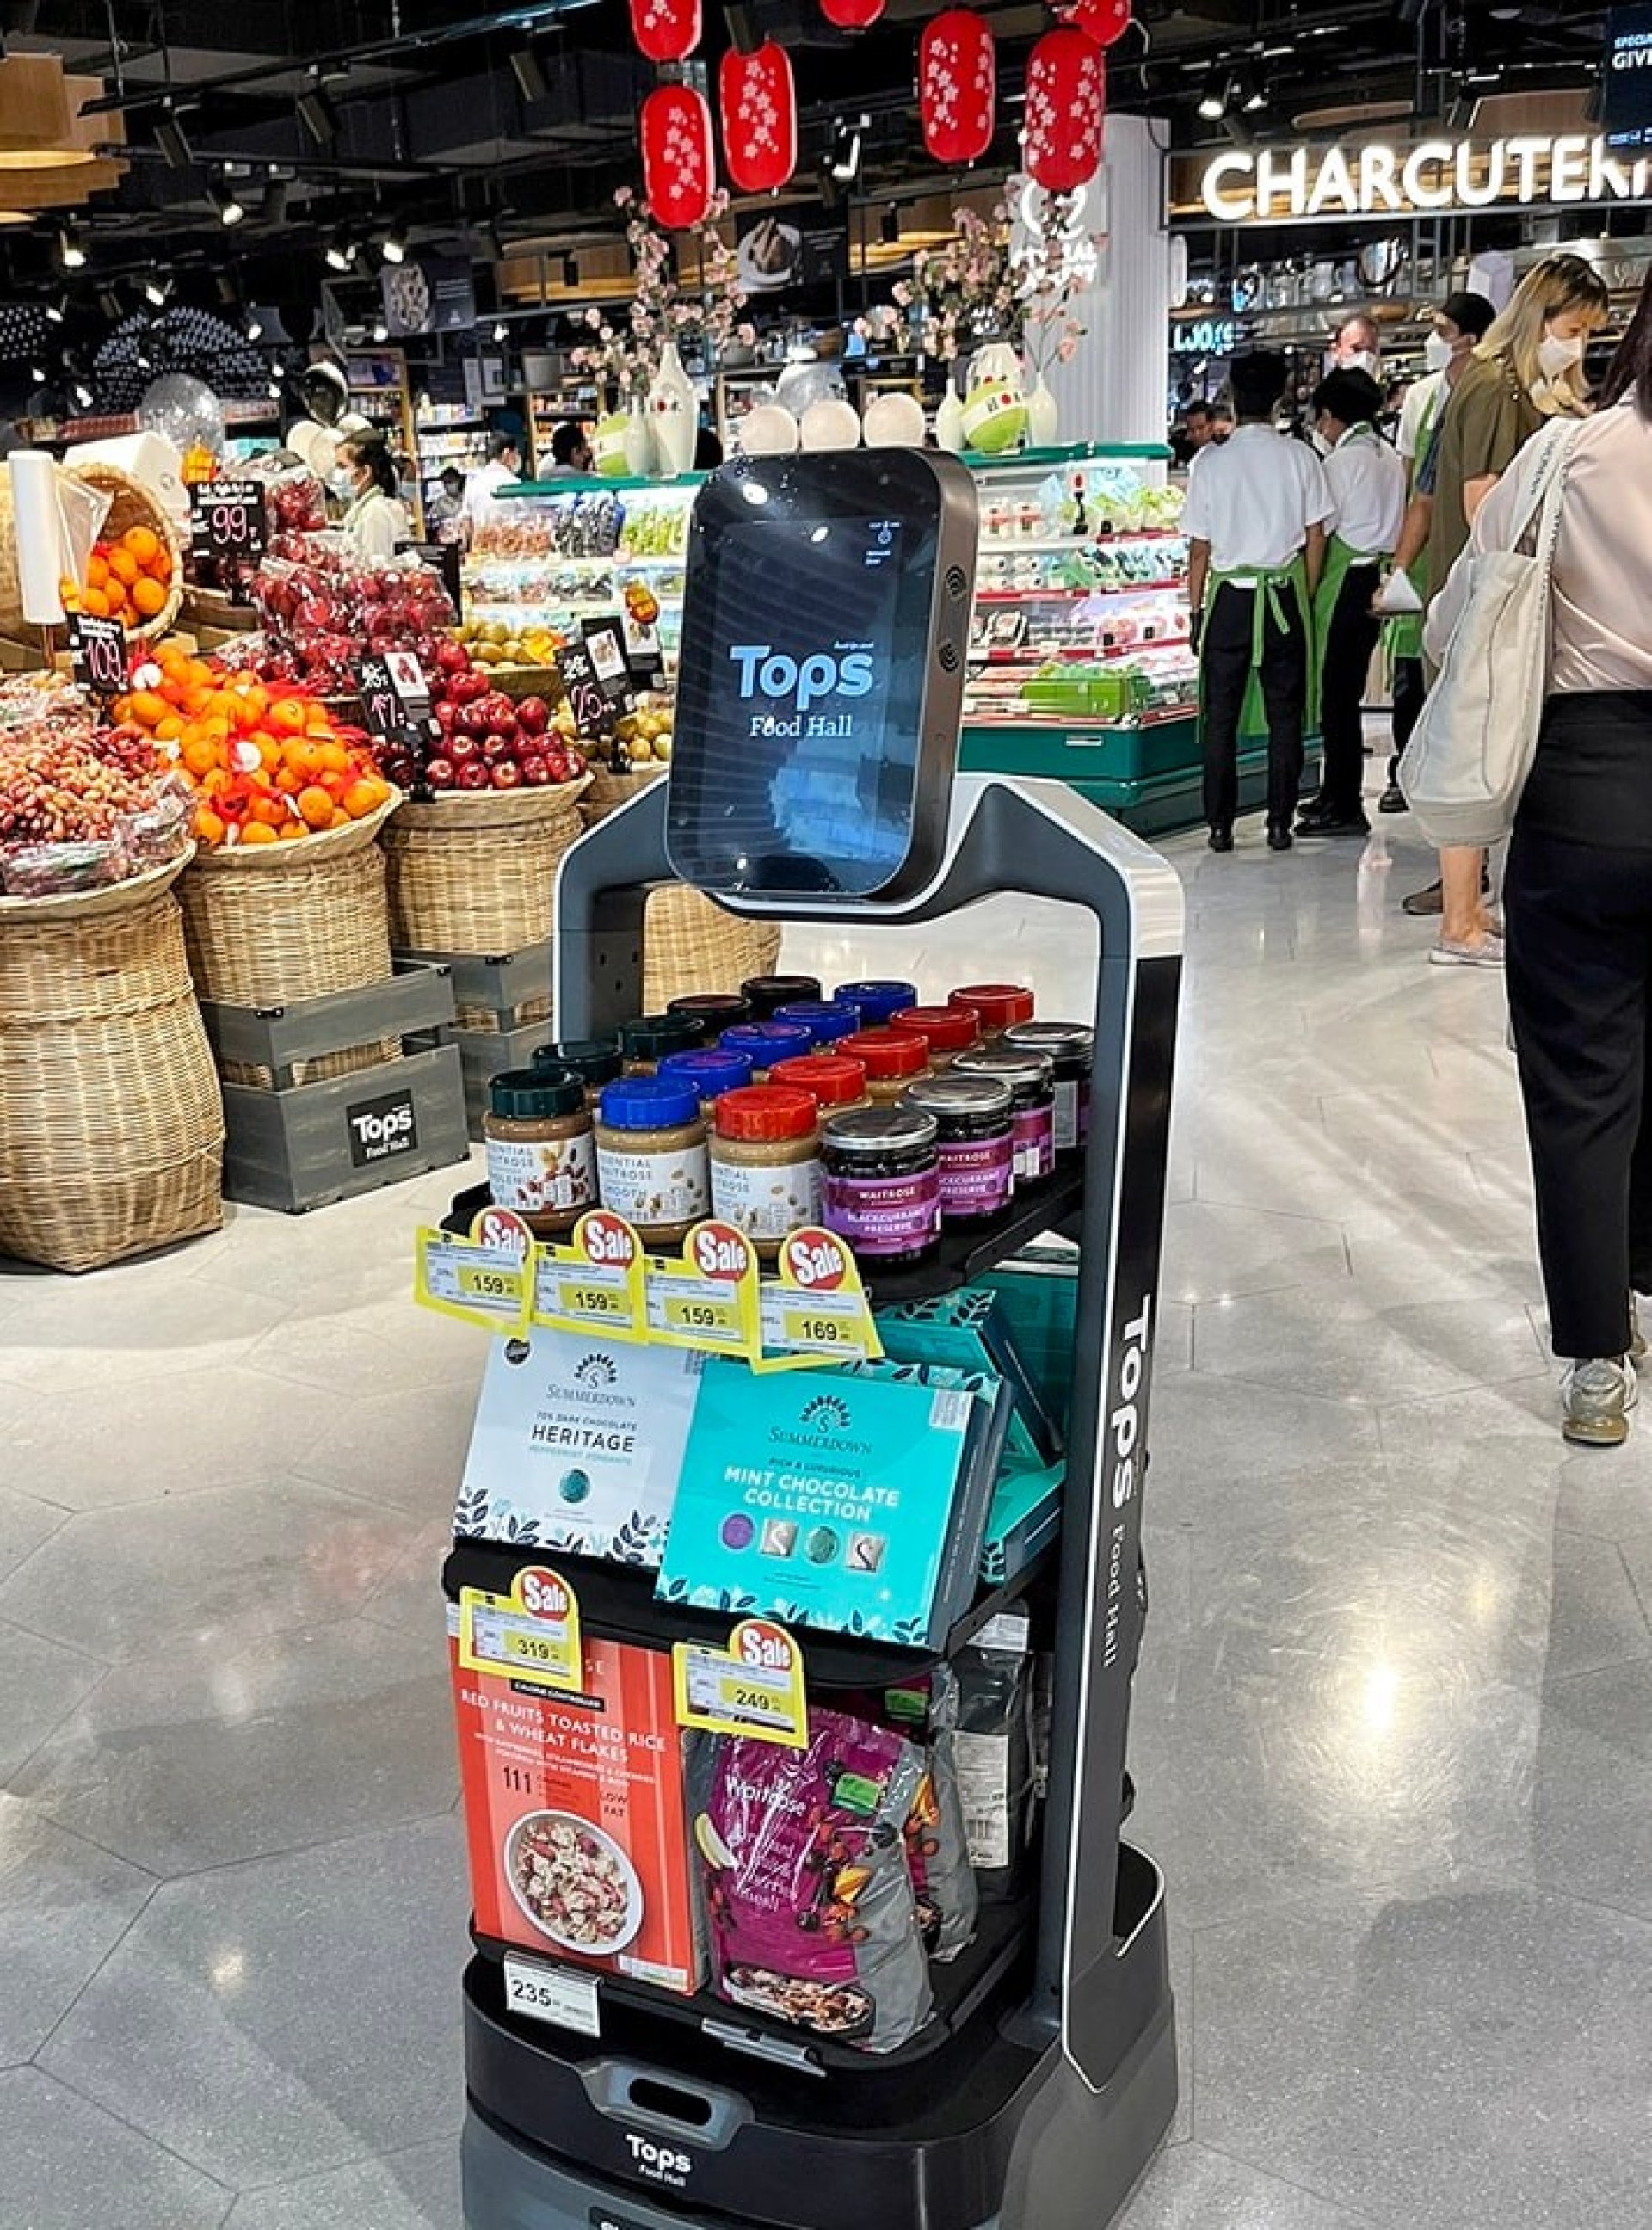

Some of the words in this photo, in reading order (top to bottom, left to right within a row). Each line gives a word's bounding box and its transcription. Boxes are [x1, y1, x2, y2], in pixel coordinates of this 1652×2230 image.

[729, 645, 874, 712] Tops
[749, 715, 801, 738] Food
[805, 715, 854, 738] Hall
[351, 1110, 412, 1143] Tops
[585, 1218, 633, 1260] Sale
[696, 1230, 747, 1272] Sale
[789, 1240, 843, 1284] Sale
[472, 1273, 503, 1294] 159
[575, 1292, 607, 1312] 159
[681, 1307, 715, 1326] 159
[801, 1320, 838, 1341] 169
[1111, 1293, 1151, 1509] Tops
[531, 1423, 635, 1453] HERITAGE
[724, 1466, 774, 1488] MINT
[778, 1474, 900, 1507] CHOCOLATE
[744, 1488, 872, 1523] COLLECTION
[521, 1573, 570, 1613] Sale
[517, 1639, 549, 1660] 319
[741, 1626, 792, 1669] Sale
[735, 1688, 768, 1710] 249
[461, 1688, 489, 1709] RED
[492, 1698, 545, 1724] FRUITS
[548, 1713, 624, 1743] TOASTED
[628, 1732, 666, 1753] RICE
[509, 1722, 565, 1747] WHEAT
[570, 1737, 628, 1762] FLAKES
[502, 1765, 531, 1795] 111
[510, 1980, 552, 2007] 235
[625, 2134, 692, 2173] Tops
